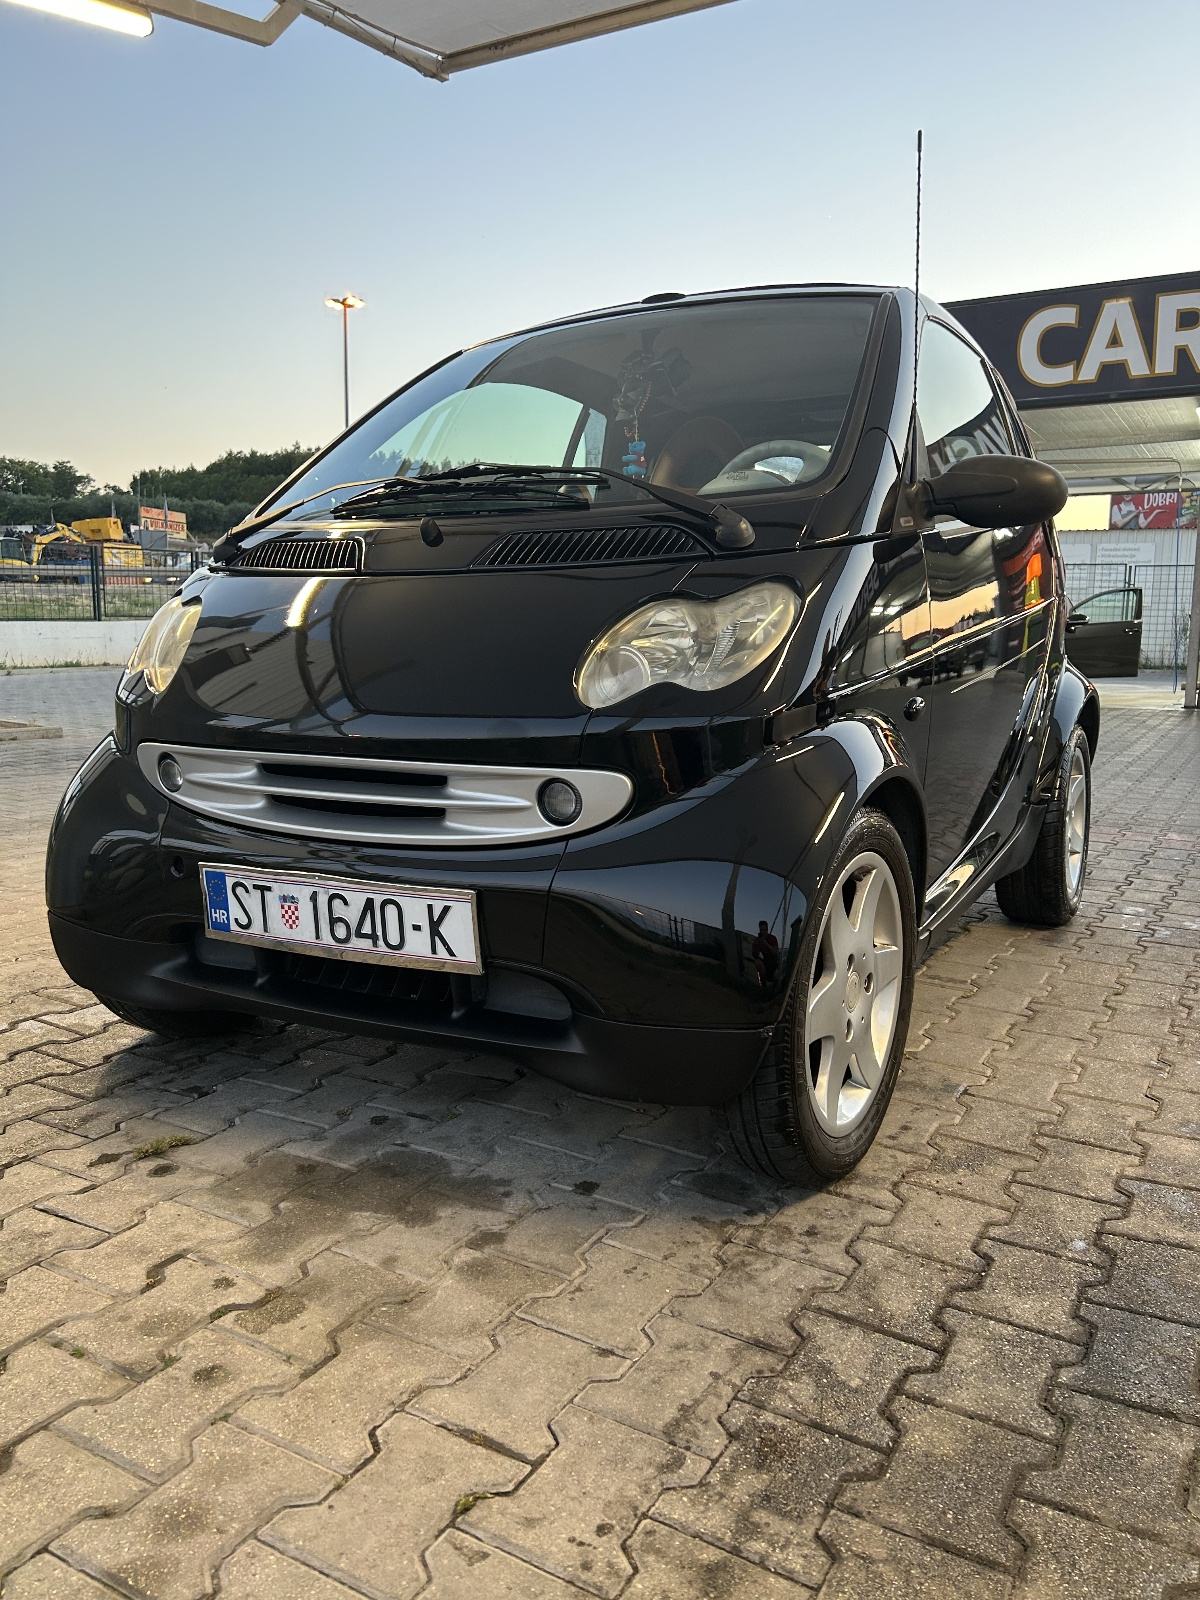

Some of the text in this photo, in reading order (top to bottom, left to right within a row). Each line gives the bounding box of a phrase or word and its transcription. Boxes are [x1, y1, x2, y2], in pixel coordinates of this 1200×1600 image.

[1017, 289, 1200, 388] CAR
[1144, 492, 1178, 509] DOBRI
[211, 908, 228, 924] HR
[231, 880, 457, 957] ST 1640-K
